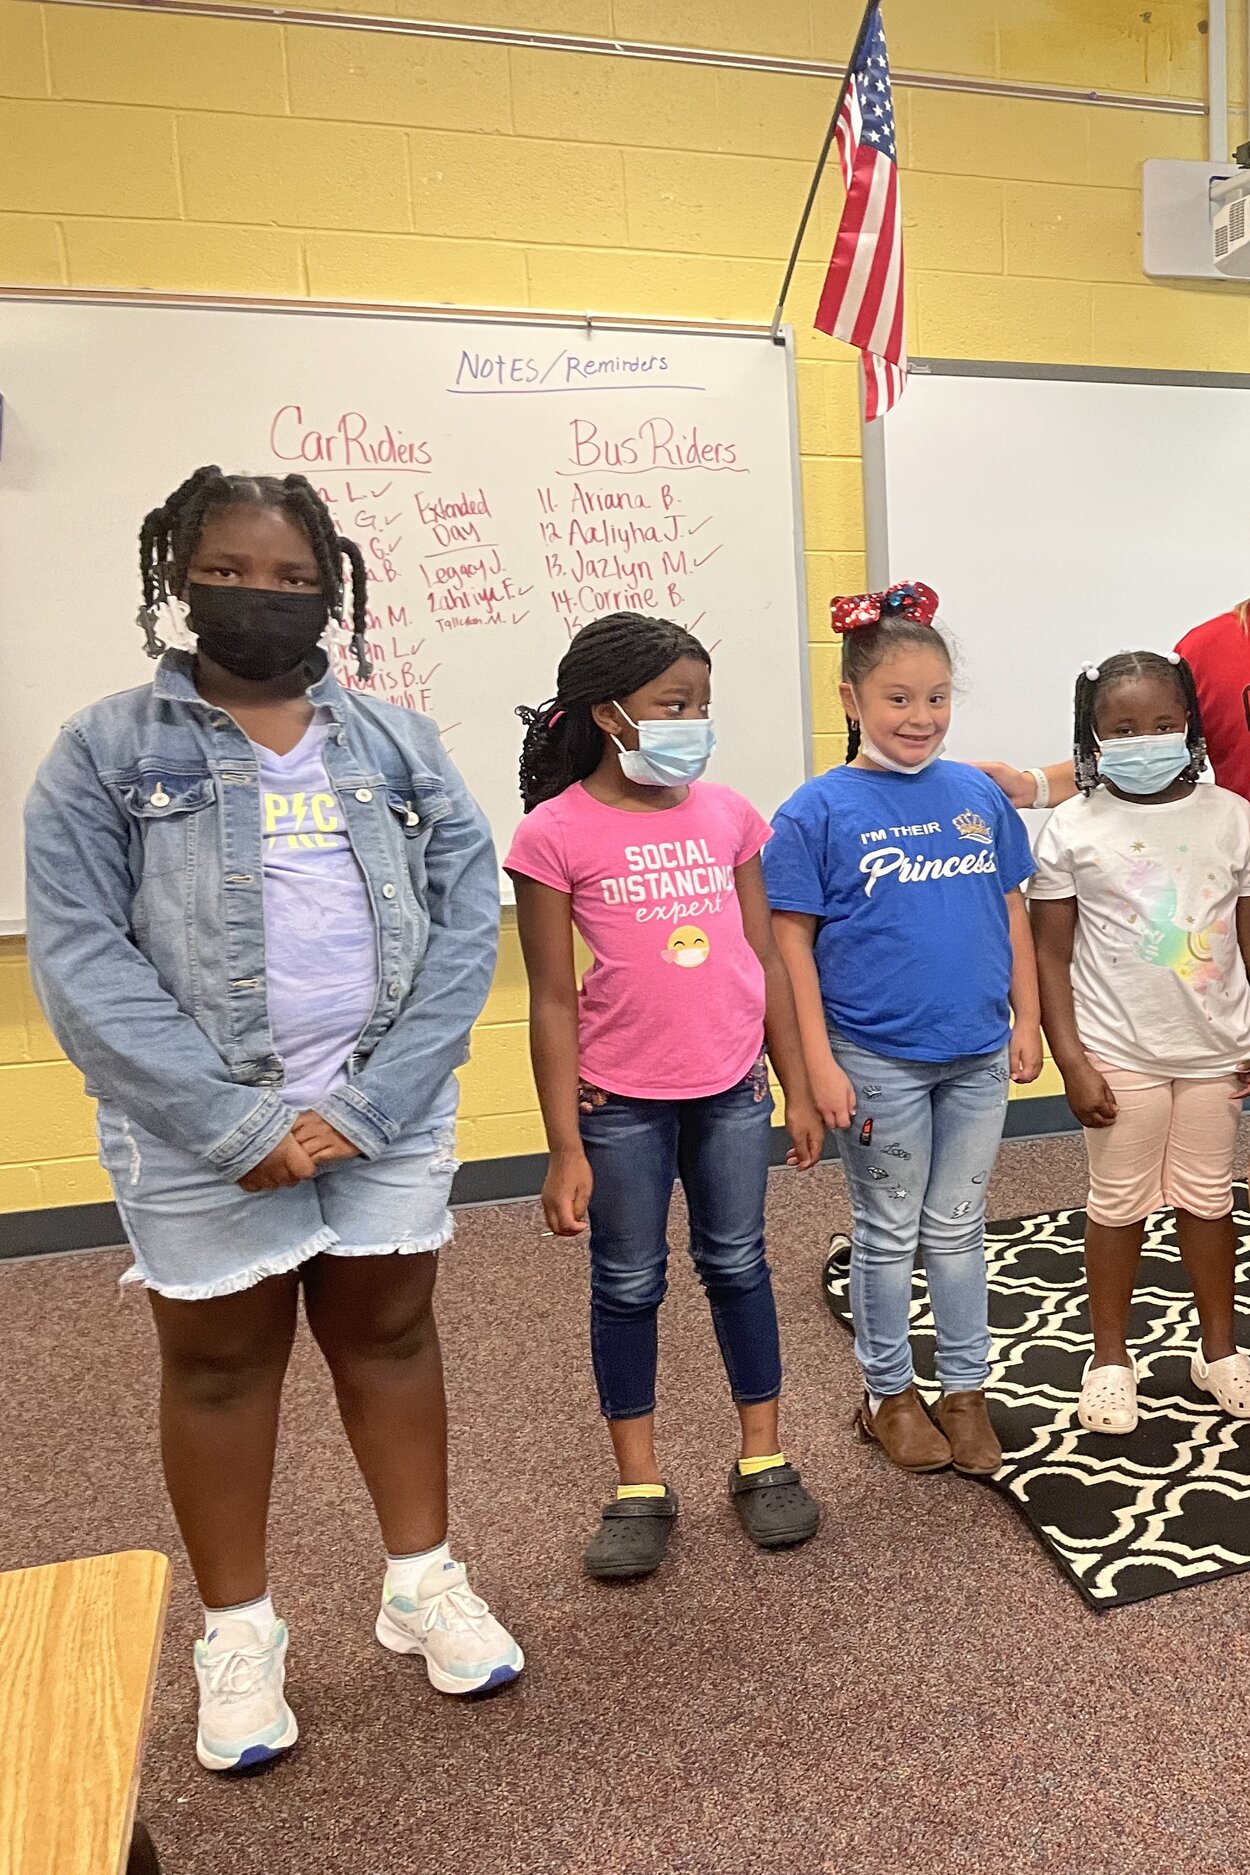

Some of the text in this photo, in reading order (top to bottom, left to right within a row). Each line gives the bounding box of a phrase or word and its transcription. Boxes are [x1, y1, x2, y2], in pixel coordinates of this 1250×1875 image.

[270, 405, 432, 465] Car Riders
[568, 417, 737, 466] Bus Riders
[570, 482, 651, 515] Ariana
[432, 521, 481, 547] Day
[419, 559, 487, 591] Legacy
[571, 550, 653, 590] Jazlyn
[577, 584, 659, 613] Corrine
[861, 820, 943, 845] I'M THEIR
[624, 838, 716, 872] SOCIAL
[859, 846, 997, 899] Princess
[635, 893, 723, 925] expert
